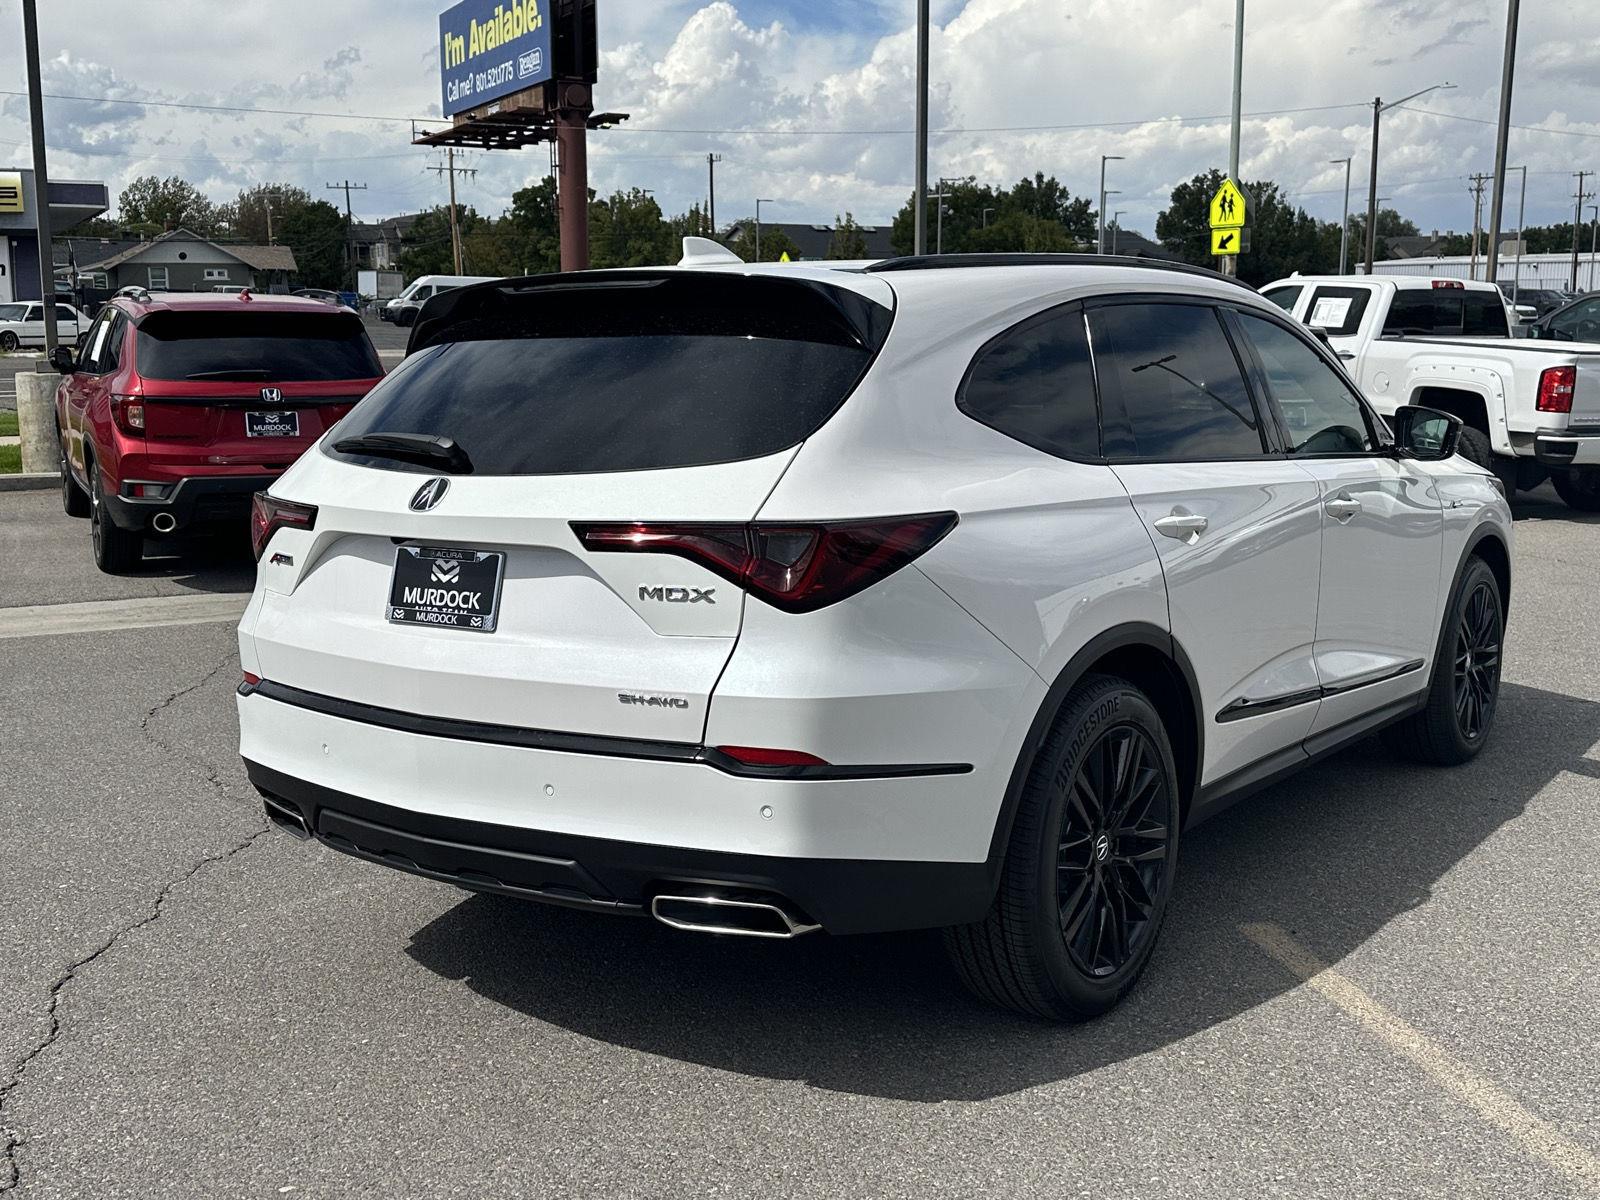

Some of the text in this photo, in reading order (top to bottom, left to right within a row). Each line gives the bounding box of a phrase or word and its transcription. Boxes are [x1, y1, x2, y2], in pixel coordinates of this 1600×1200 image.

[445, 0, 542, 70] I'm Available.
[447, 79, 459, 102] Call
[460, 72, 474, 97] me?
[435, 551, 463, 559] ACURA
[403, 586, 481, 610] MURDOCK
[638, 586, 716, 605] MDX
[416, 611, 458, 624] MURDOCK
[1056, 696, 1120, 788] BRIDGESTONE
